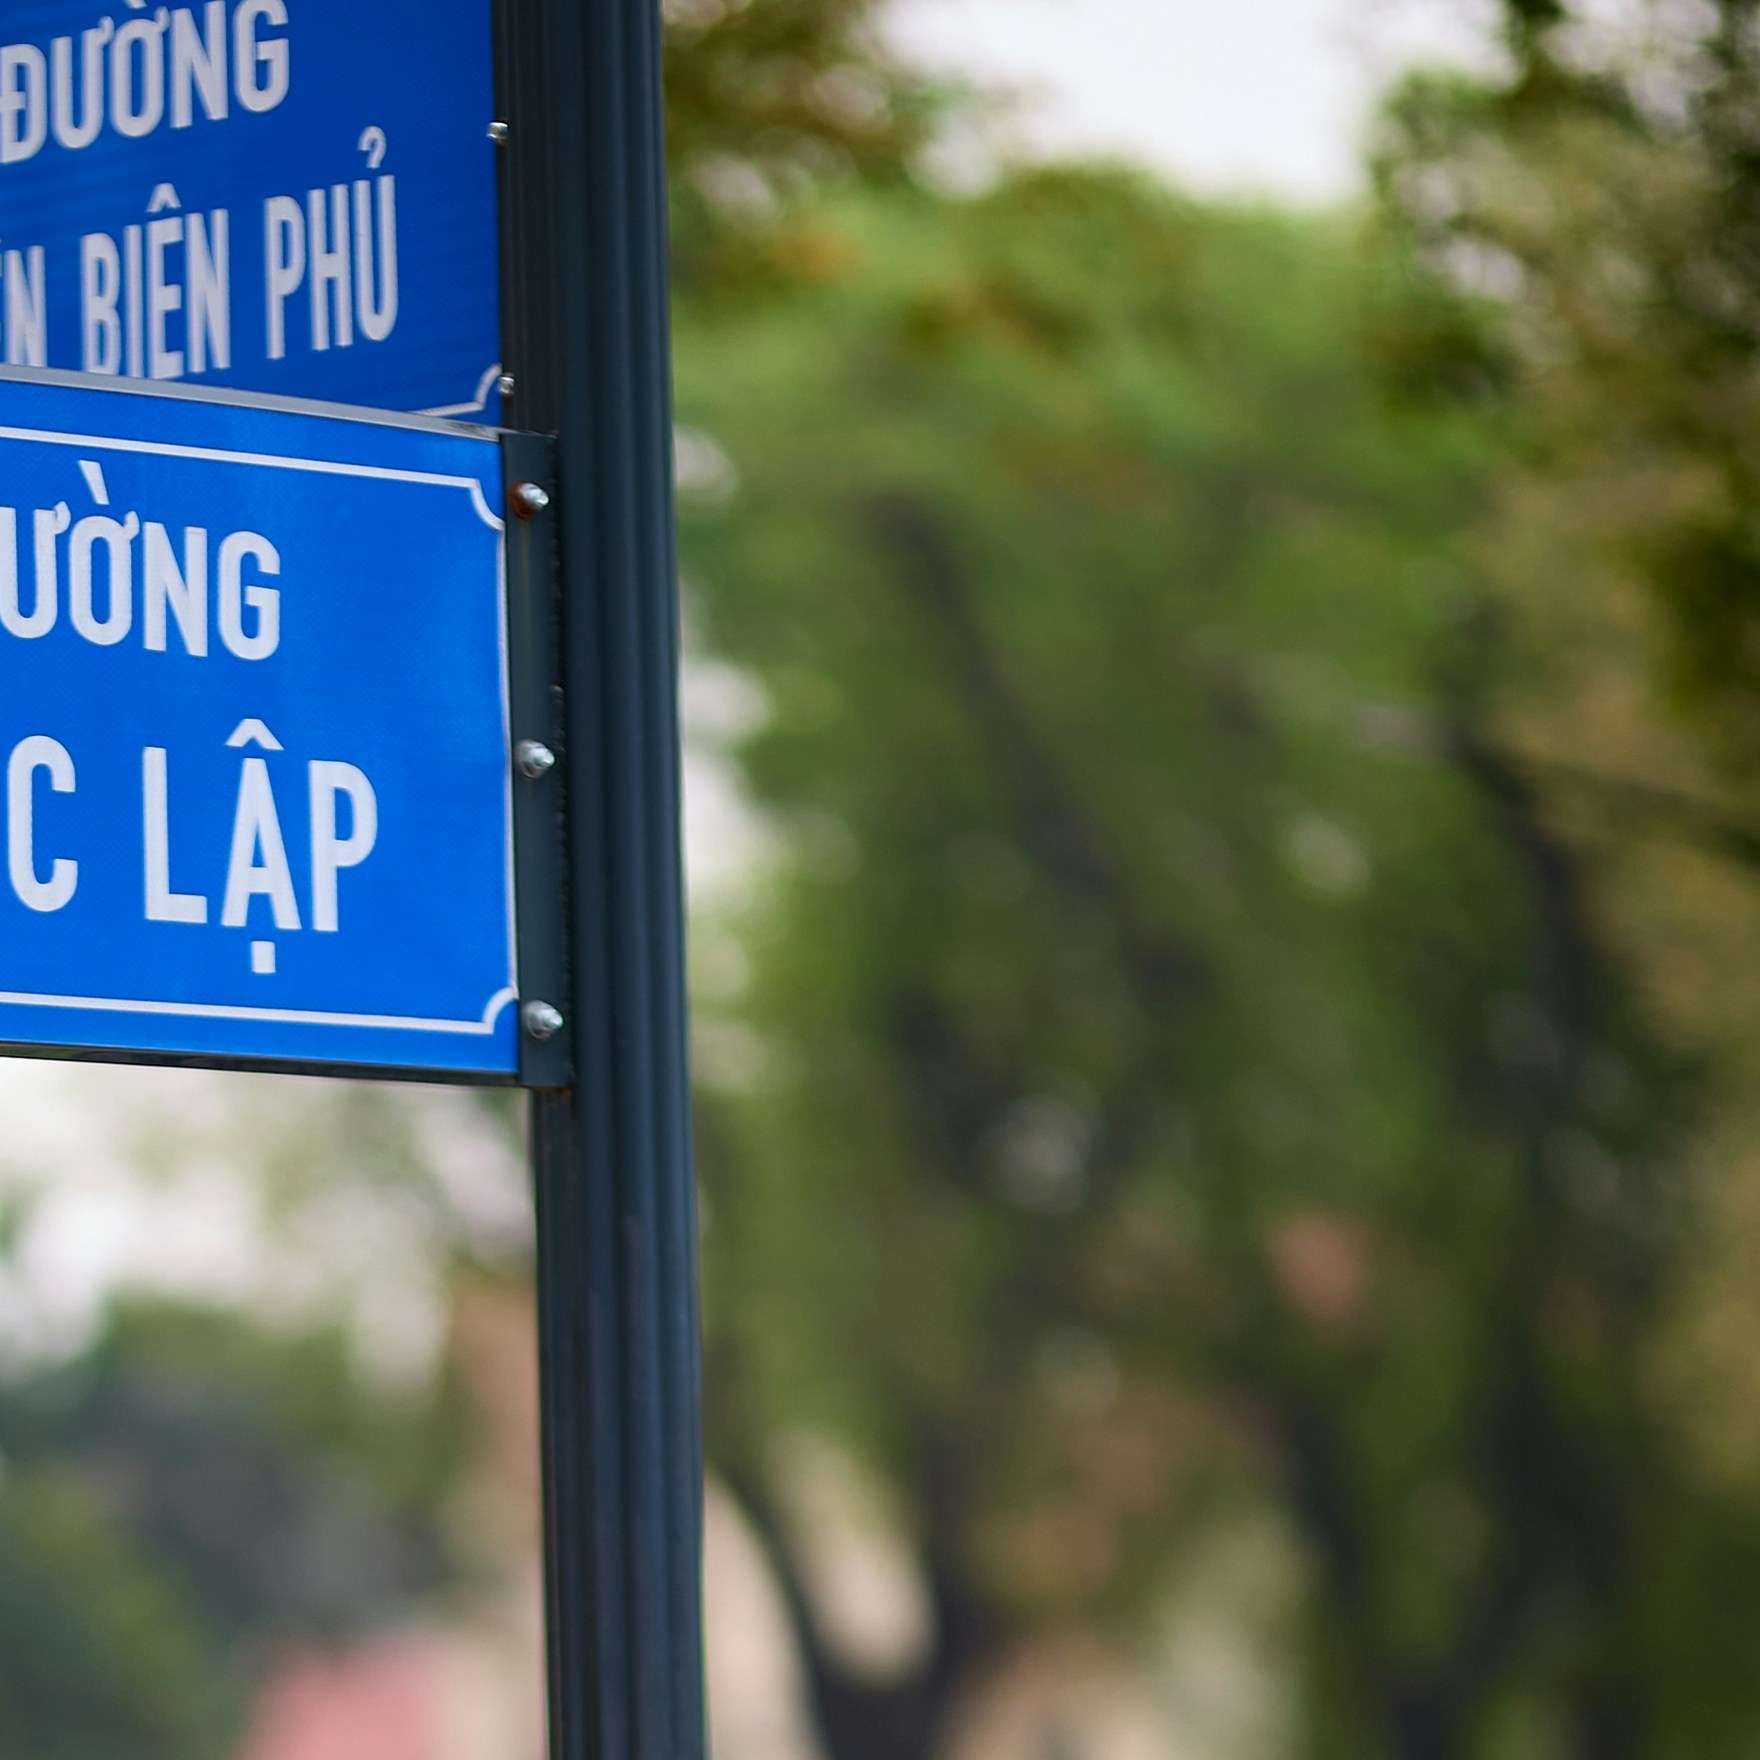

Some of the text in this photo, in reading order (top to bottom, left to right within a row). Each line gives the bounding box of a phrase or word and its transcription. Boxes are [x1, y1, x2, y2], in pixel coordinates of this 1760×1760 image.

[81, 183, 230, 379] BIÊN
[266, 126, 399, 360] PHỦ
[142, 718, 378, 974] LẬP
